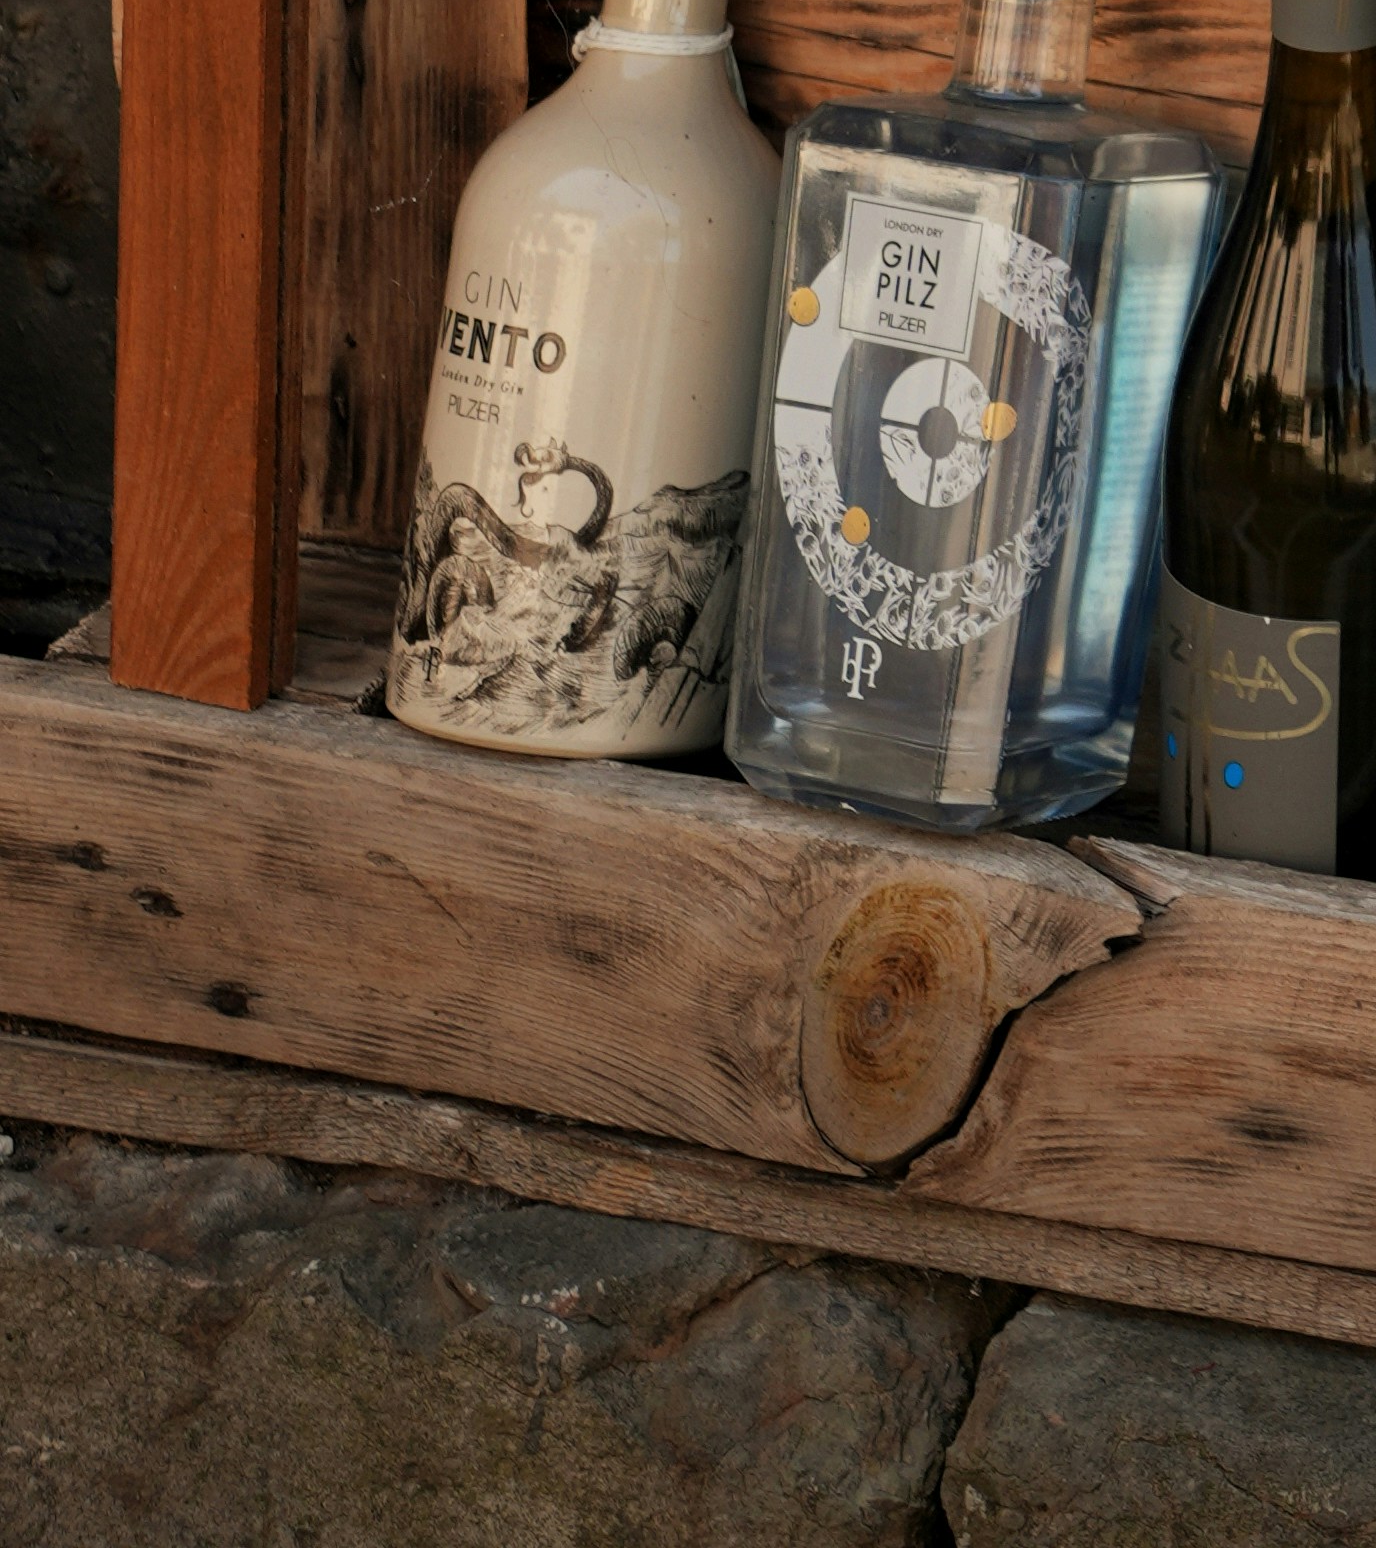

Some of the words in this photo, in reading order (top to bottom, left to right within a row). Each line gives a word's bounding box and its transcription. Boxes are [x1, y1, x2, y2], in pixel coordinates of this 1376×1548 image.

[884, 218, 926, 238] LONDON
[926, 226, 944, 240] DRY
[881, 239, 943, 278] GIN
[464, 270, 524, 314] GIN
[876, 270, 939, 311] PILZ
[439, 305, 568, 376] VENTO
[878, 310, 928, 336] PILZER
[447, 393, 502, 427] PILZER
